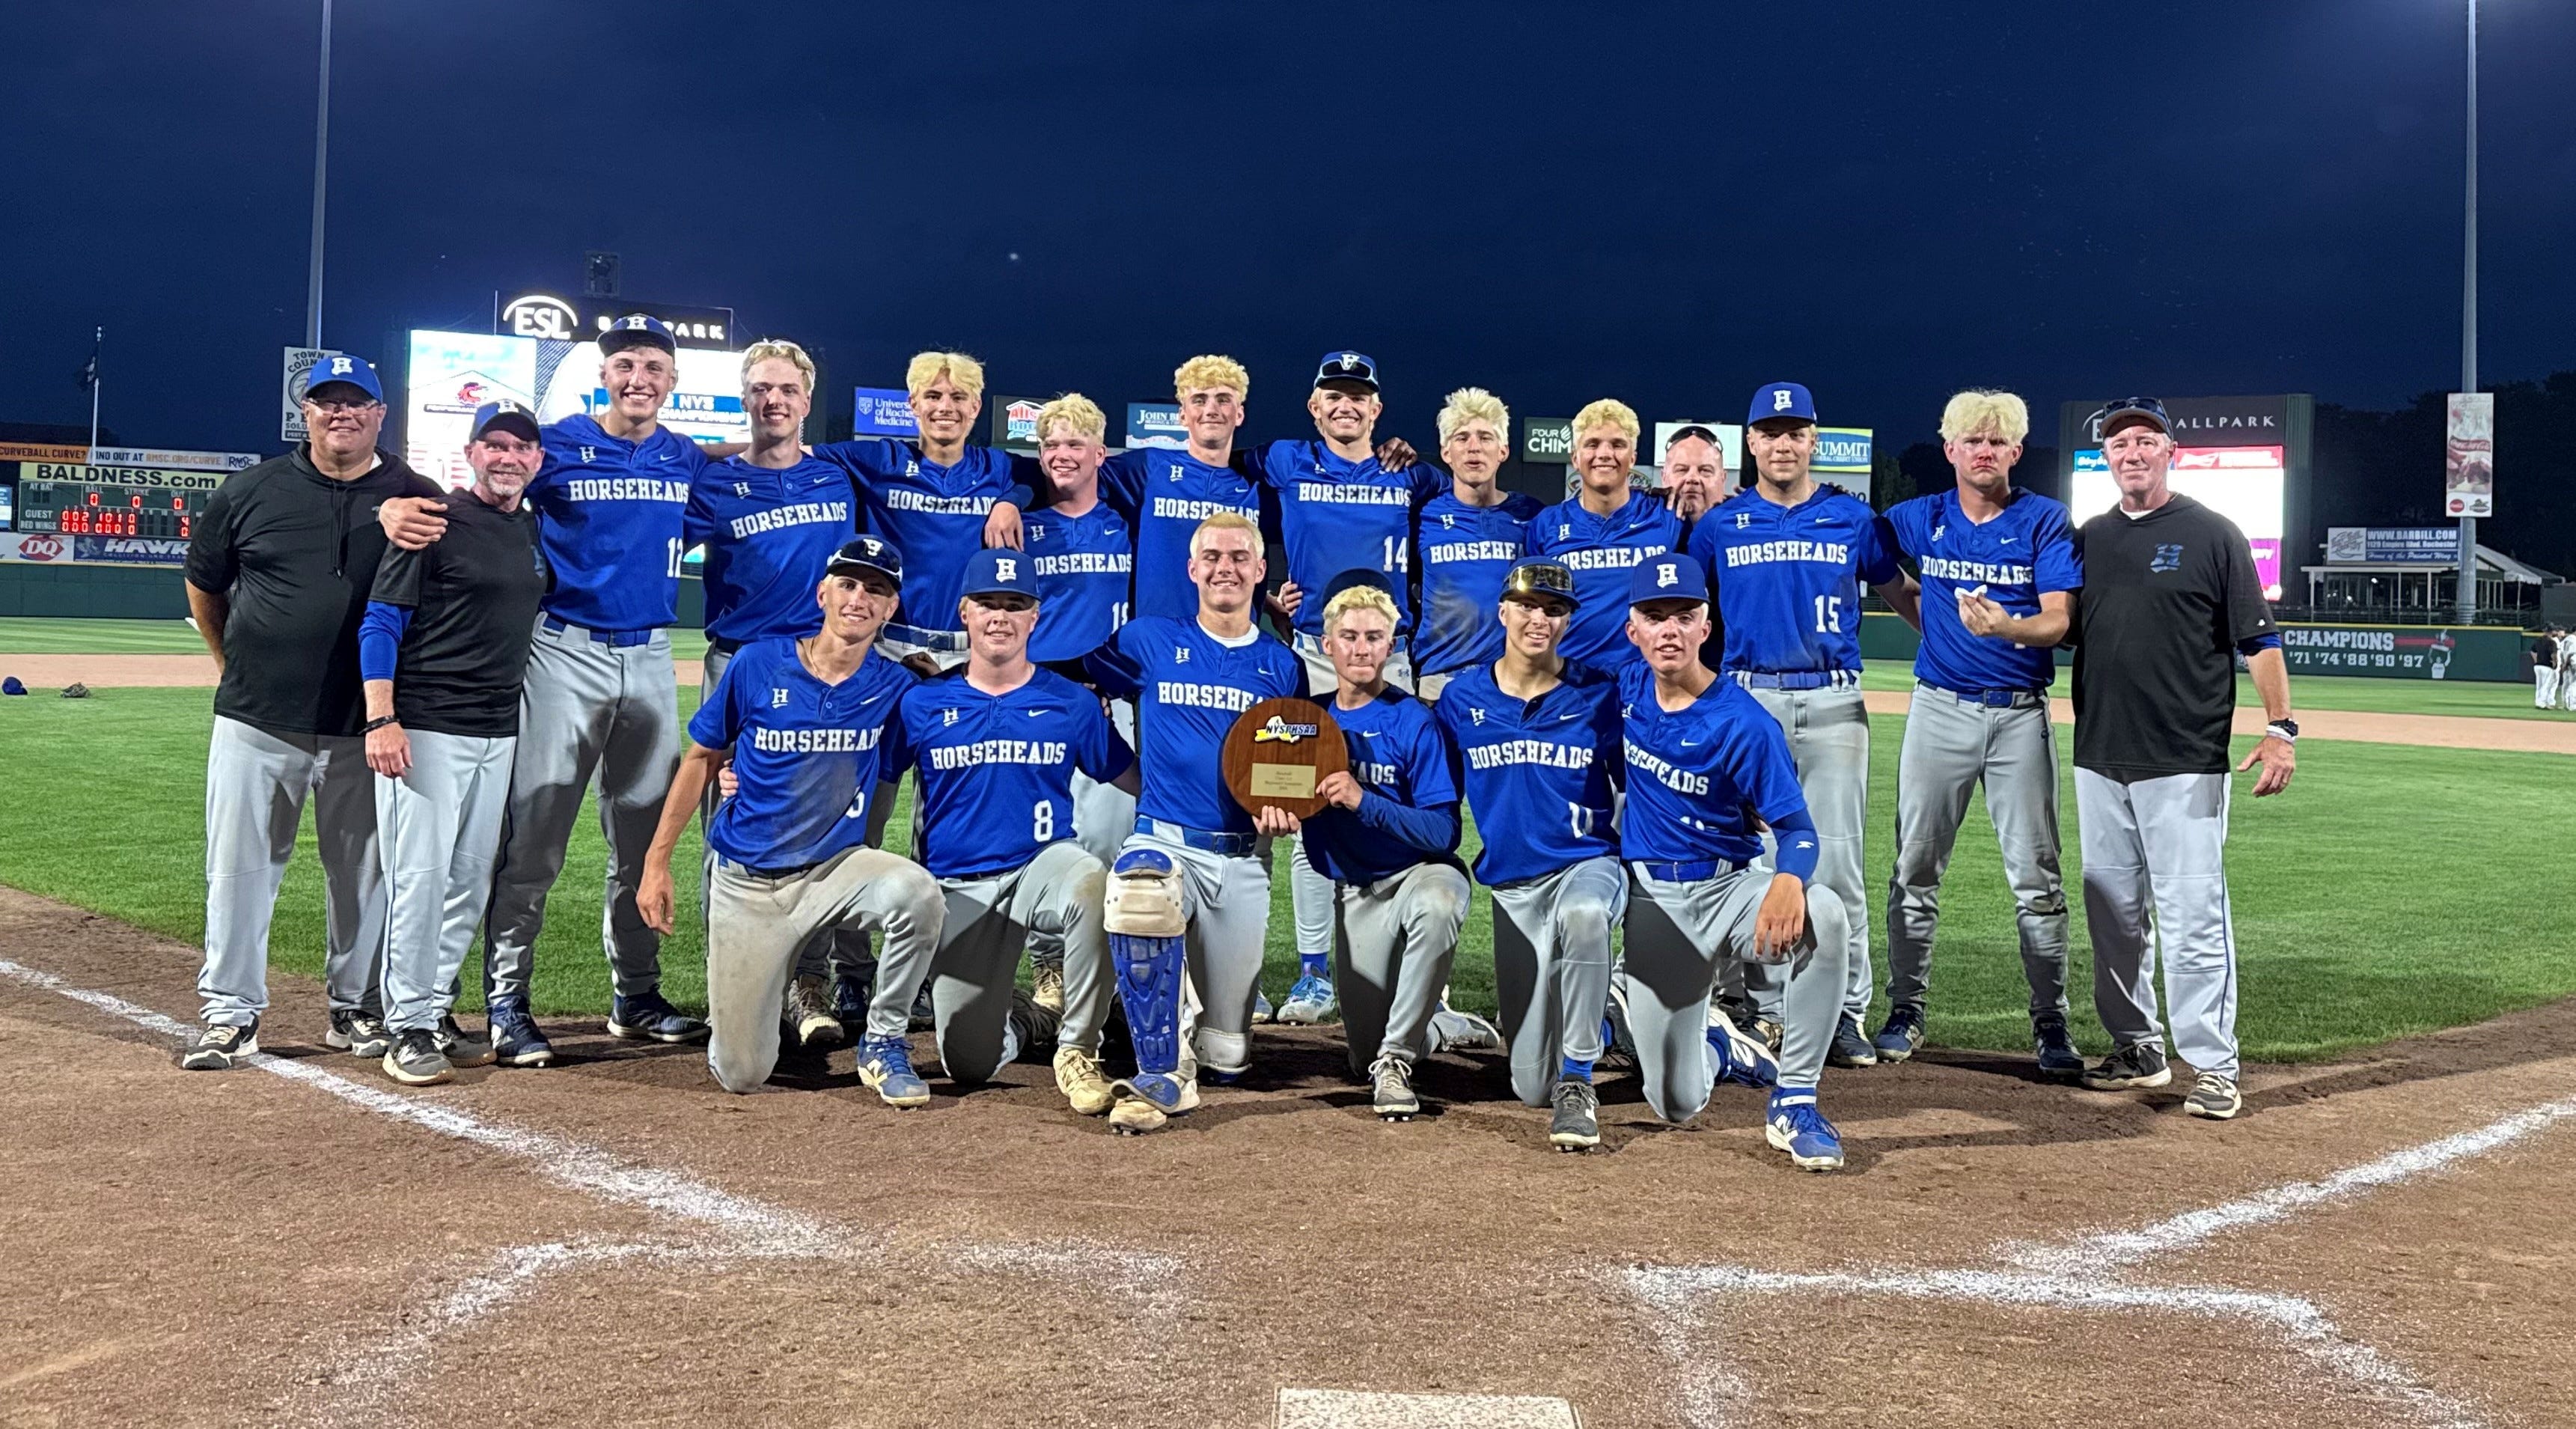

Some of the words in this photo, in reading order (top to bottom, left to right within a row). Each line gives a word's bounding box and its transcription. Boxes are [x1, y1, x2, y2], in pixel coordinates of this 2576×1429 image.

[515, 305, 570, 340] ESL
[626, 316, 647, 330] H
[293, 350, 325, 360] TOWN
[332, 357, 352, 375] H
[1773, 389, 1792, 412] H
[873, 415, 913, 427] Medicine
[1136, 409, 1168, 424] JOHN
[1531, 429, 1559, 438] FOUR
[52, 448, 85, 459] CURVE?
[95, 451, 111, 460] IND
[112, 451, 129, 461] OUT
[132, 453, 144, 461] AT
[1813, 441, 1871, 457] SUMMIT
[37, 464, 216, 489] BALDNESS.com
[1170, 464, 1184, 482] H
[568, 478, 689, 504] HORSEHEADS
[1299, 482, 1413, 508] HORSEHEADS
[90, 493, 99, 506] 0
[132, 496, 141, 508] 0
[173, 497, 183, 510] 0
[887, 489, 998, 516] HORSEHEAD
[25, 509, 54, 519] GUEST
[730, 502, 847, 539] HORSEHEADS
[1736, 513, 1751, 529] H
[20, 520, 34, 529] RED
[35, 521, 57, 529] WINGS
[1031, 525, 1046, 542] H
[1558, 524, 1570, 541] H
[2367, 530, 2457, 540] WWW.BARBILL.COM
[25, 539, 59, 557] DQ
[2381, 540, 2405, 549] Empire
[1383, 535, 1408, 573] 14
[1725, 540, 1849, 568] HORSEHEADS
[2433, 552, 2452, 561] Wing
[995, 558, 1016, 583] H
[1034, 552, 1132, 576] ORSEHEADS
[1921, 555, 2033, 585] HORSEHEADS
[1656, 564, 1679, 588] H
[1814, 594, 1842, 633] 15
[2284, 630, 2395, 651] CHAMPIONS
[1175, 646, 1190, 664] H
[2289, 651, 2311, 665] '71
[2315, 652, 2340, 665] '74
[2342, 653, 2368, 666] '88
[2369, 653, 2396, 667] '90
[2399, 654, 2424, 668] '97
[772, 688, 789, 709] H
[942, 707, 959, 728] H
[1266, 724, 1317, 735] NYSPHSAA
[930, 740, 1066, 770] HORSEHEADS
[1467, 740, 1593, 770] HORSEHEADS
[1034, 799, 1054, 843] 8
